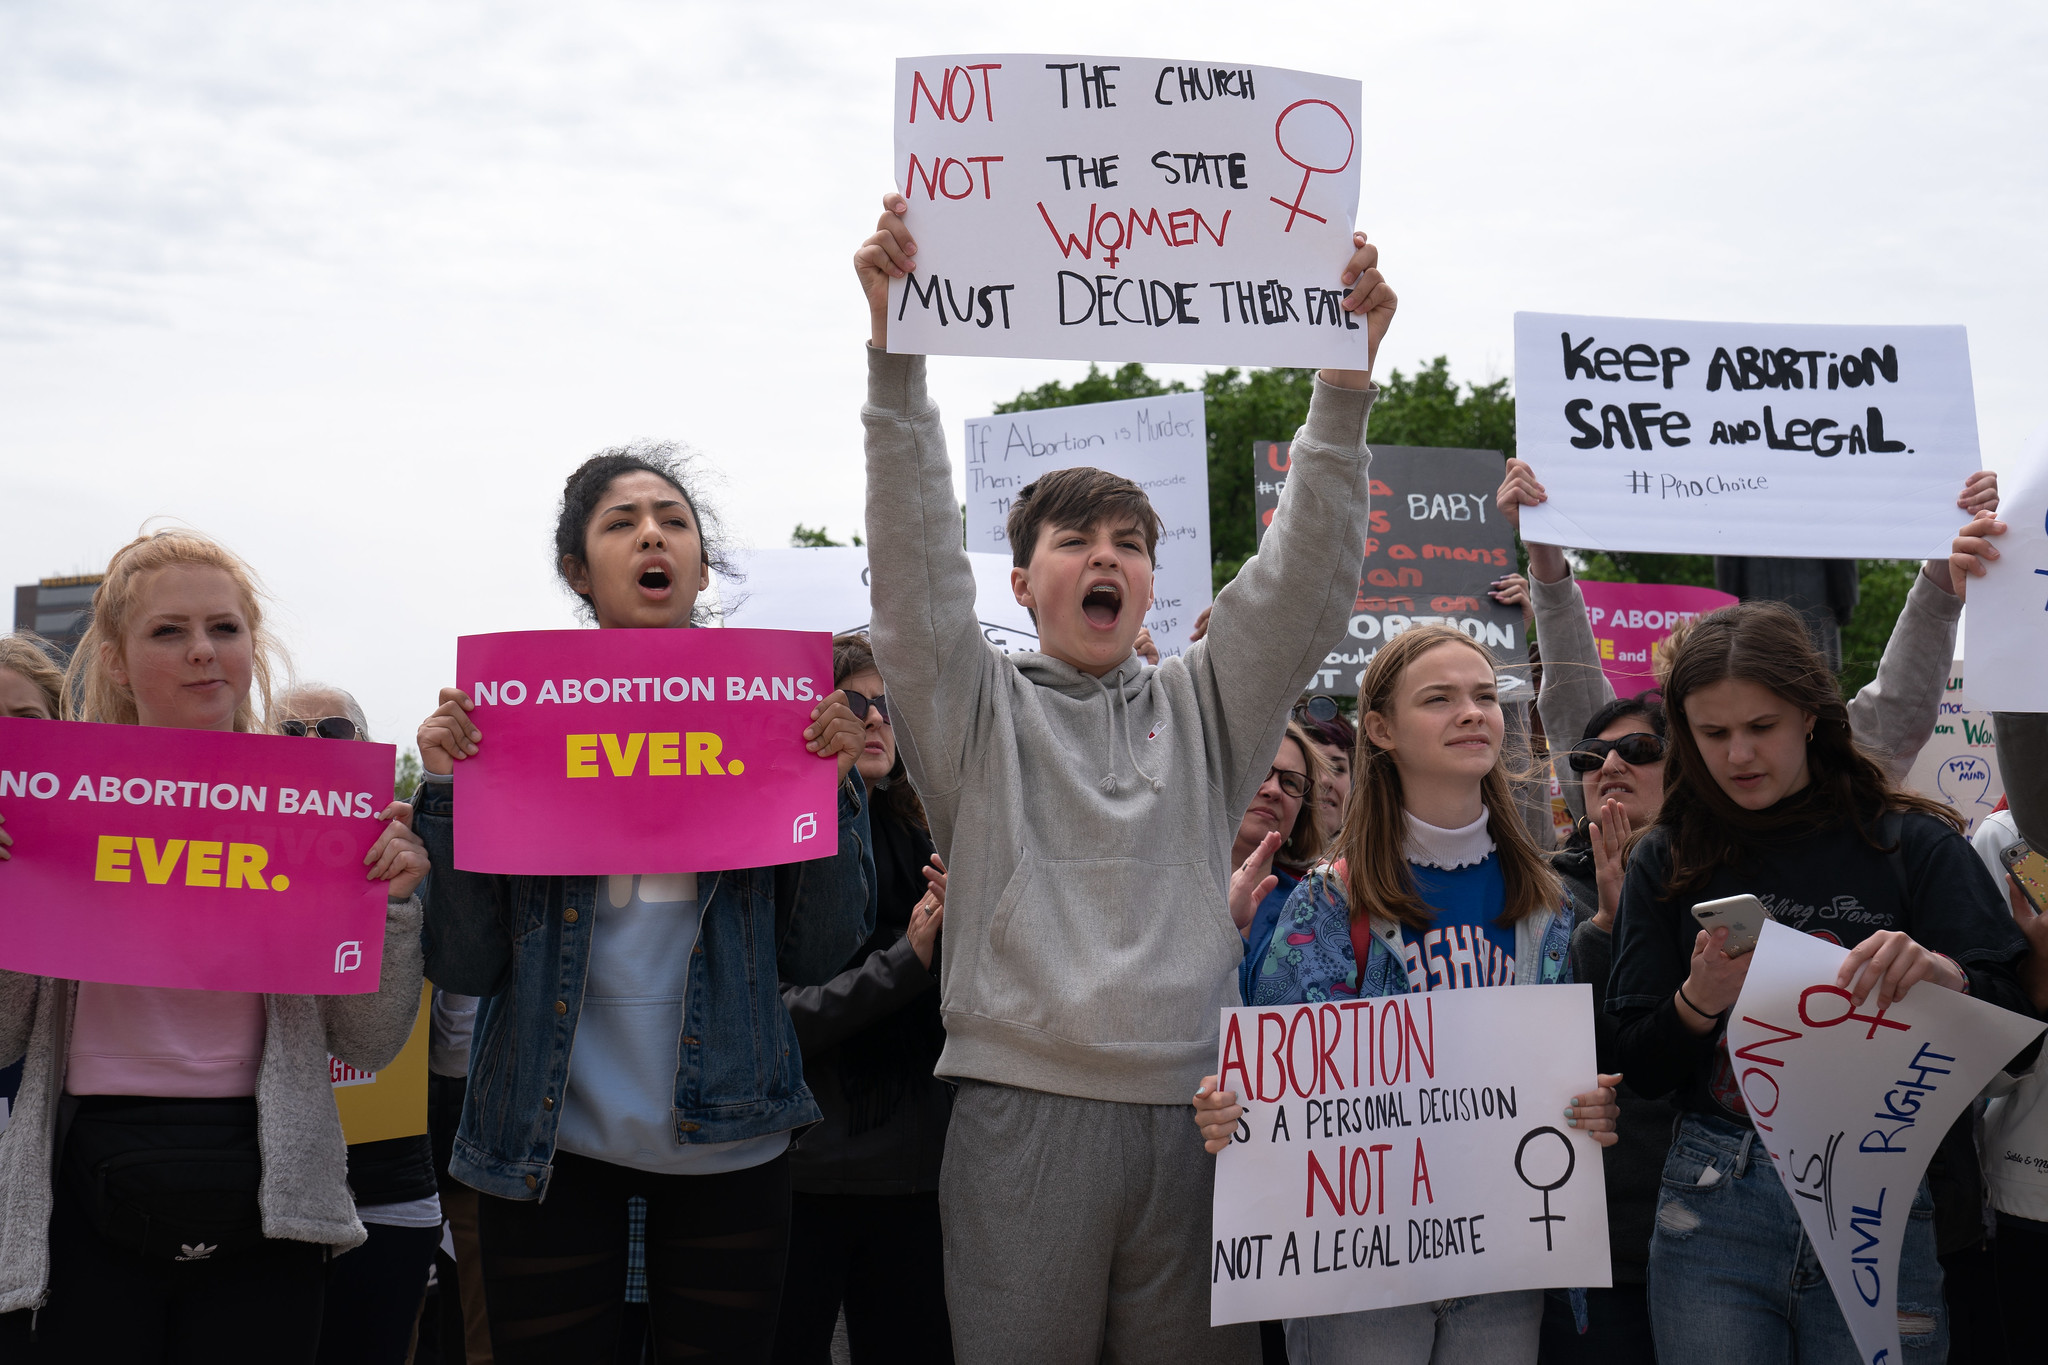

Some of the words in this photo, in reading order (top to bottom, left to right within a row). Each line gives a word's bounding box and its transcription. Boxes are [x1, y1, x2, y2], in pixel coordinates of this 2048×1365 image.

[908, 62, 1003, 126] NOT
[1044, 62, 1122, 110] THE
[1154, 64, 1257, 106] CHURCH
[905, 152, 1005, 201] NOT
[1046, 154, 1120, 191] THE
[1151, 150, 1249, 190] STATE
[1036, 199, 1232, 270] WOMEN
[898, 272, 1016, 330] MUST
[1057, 270, 1200, 328] DECIDE
[1209, 279, 1300, 326] THEIR
[1303, 284, 1361, 330] FATE
[967, 422, 992, 464] If
[1003, 421, 1105, 463] Abortion
[1136, 407, 1196, 443] Murder,
[1709, 419, 1761, 446] AND
[969, 466, 1022, 493] Then:
[1407, 493, 1489, 524] BABY
[1388, 544, 1418, 560] a
[1422, 544, 1508, 567] mans
[1155, 597, 1182, 611] the
[1431, 595, 1480, 612] on
[1610, 609, 1701, 630] ABORT
[1143, 617, 1178, 634] rugs
[1348, 614, 1515, 650] ORON
[1323, 647, 1377, 665] ould
[1619, 649, 1646, 663] and
[474, 680, 528, 706] NO
[535, 676, 715, 705] ABORTION
[726, 676, 824, 702] BANS.
[566, 731, 745, 778] EVER.
[1950, 760, 1976, 772] MY
[1959, 771, 1986, 781] MIND
[0, 770, 60, 800] NO
[68, 774, 268, 812] ABORTION
[277, 787, 382, 819] BANS.
[94, 836, 292, 892] EVER.
[1818, 895, 1894, 926] Stones
[1220, 998, 1434, 1103] ABORTION
[1229, 1107, 1251, 1144] S
[1271, 1105, 1290, 1143] A
[1306, 1092, 1411, 1140] PERSONAL
[1419, 1086, 1517, 1124] DECISION
[1859, 1042, 1957, 1154] RIGHT
[1305, 1144, 1393, 1218] NOT
[1411, 1137, 1434, 1206] A
[1213, 1234, 1272, 1283] NOT
[1279, 1231, 1300, 1276] A
[1313, 1225, 1399, 1273] LEGAL
[1409, 1214, 1485, 1263] DEBATE
[1850, 1186, 1887, 1308] CIVIL
